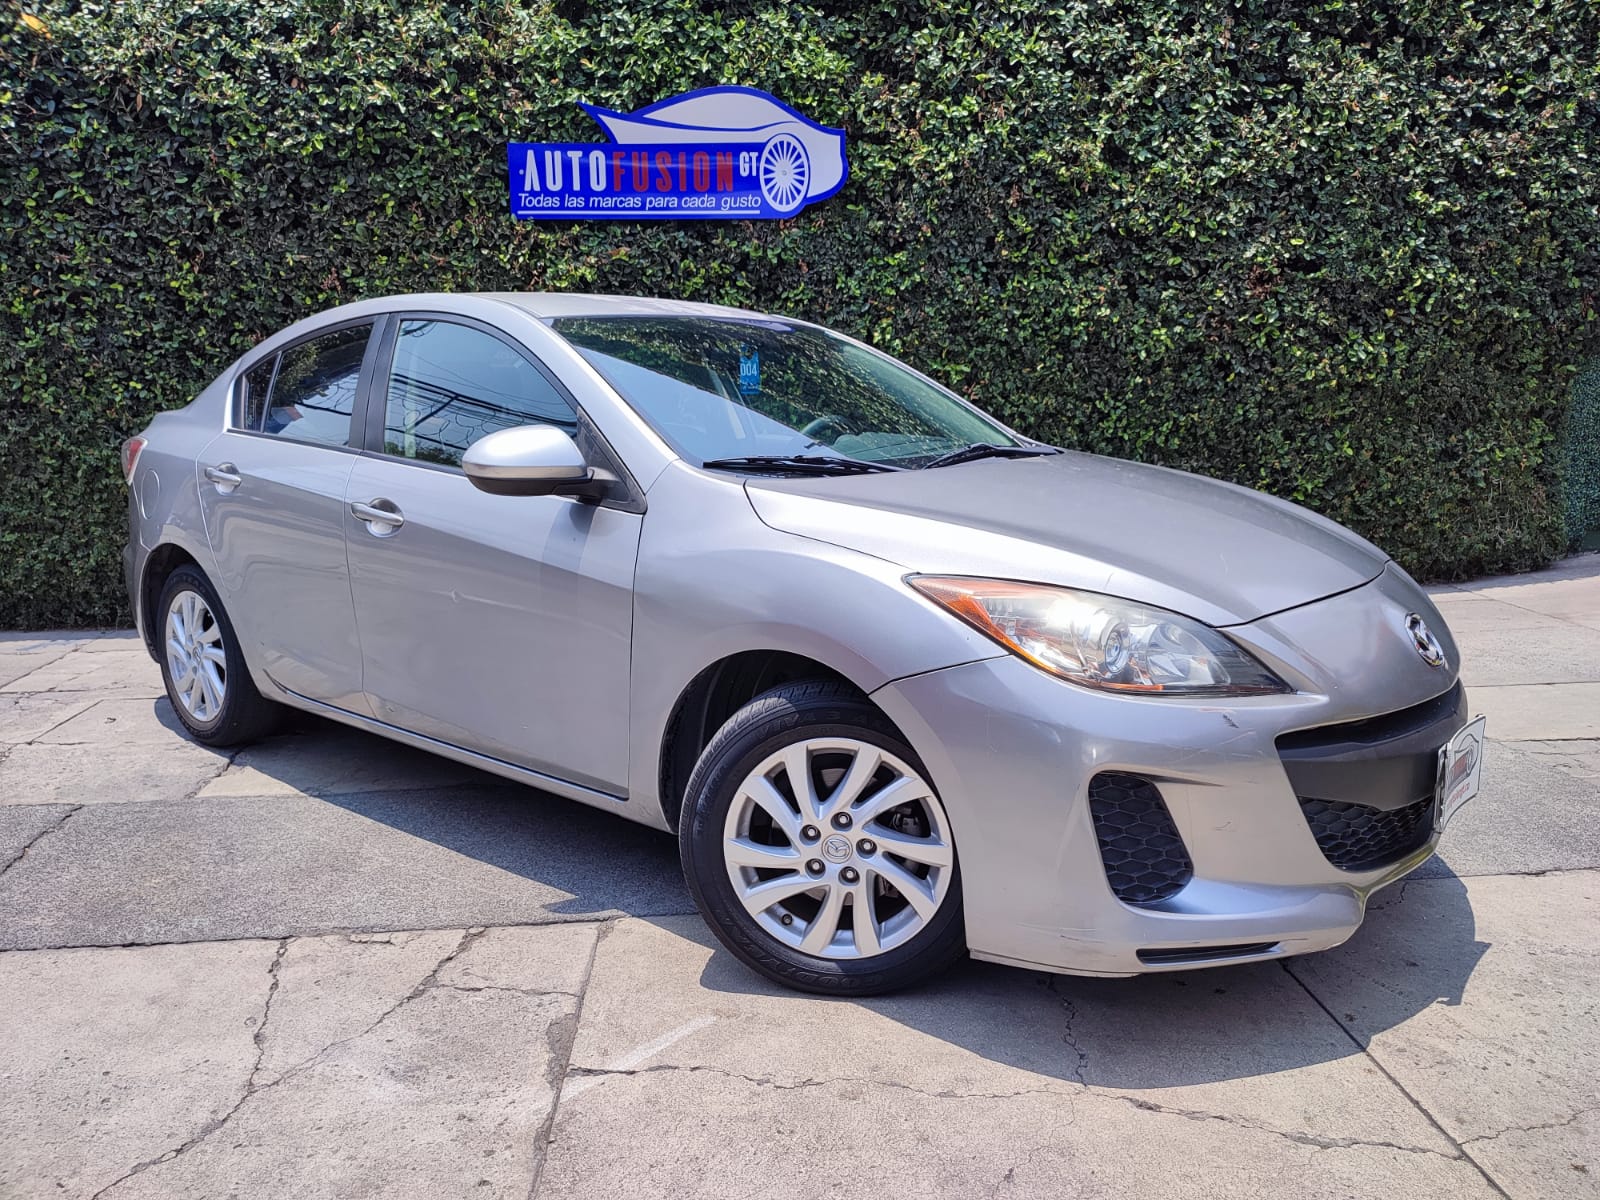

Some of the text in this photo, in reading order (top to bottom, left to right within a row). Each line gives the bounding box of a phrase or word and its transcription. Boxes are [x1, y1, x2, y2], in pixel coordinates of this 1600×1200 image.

[739, 151, 759, 177] GT
[518, 193, 761, 210] Todas las marcas para cada gusto
[740, 363, 757, 376] 004
